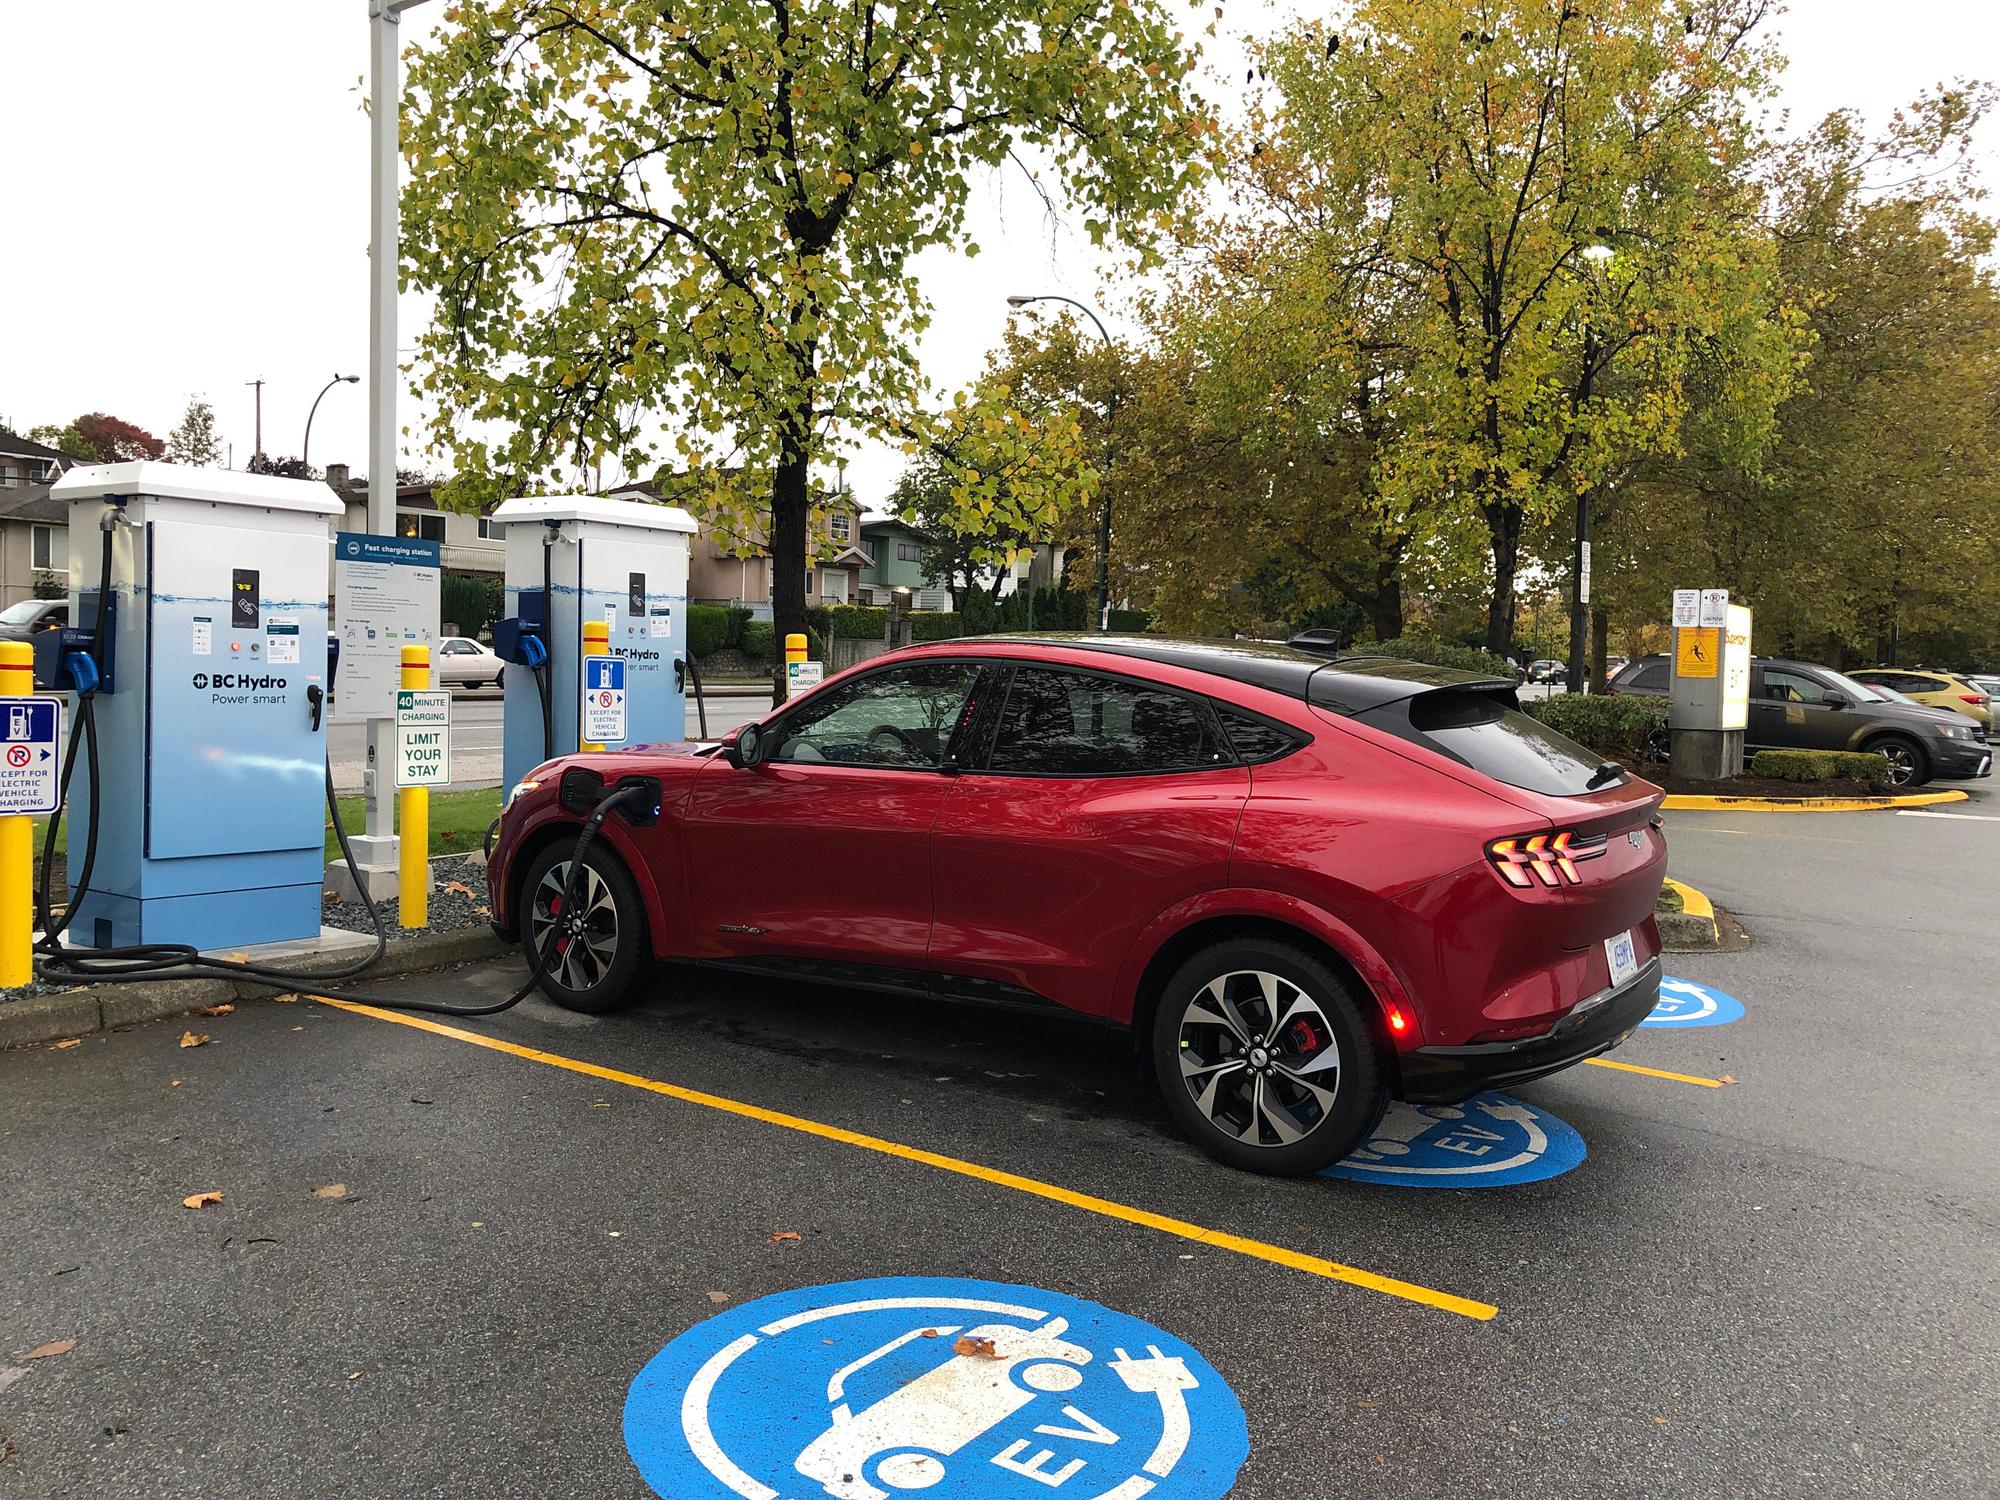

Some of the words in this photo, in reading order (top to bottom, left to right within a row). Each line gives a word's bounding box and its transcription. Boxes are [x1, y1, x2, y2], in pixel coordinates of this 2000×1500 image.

[364, 543, 380, 552] Fast
[381, 544, 410, 555] charging
[411, 548, 433, 557] station
[615, 648, 628, 658] BC
[630, 648, 660, 661] Hydro
[790, 666, 799, 675] 40
[212, 674, 235, 689] BC
[237, 674, 287, 691] Hydro
[212, 693, 249, 704] Power
[252, 694, 286, 704] smart
[399, 696, 412, 707] 40
[414, 698, 446, 707] MINUTE
[401, 713, 445, 721] CHARGING
[14, 718, 21, 736] EV
[406, 733, 440, 745] LIMIT
[405, 749, 441, 761] YOUR
[0, 770, 26, 778] CEPT
[29, 769, 48, 777] FOR
[408, 765, 439, 777] STAY
[0, 779, 41, 788] LECTRIC
[0, 798, 44, 807] HARGING
[1432, 1124, 1505, 1157] EV
[989, 1404, 1121, 1488] EV
